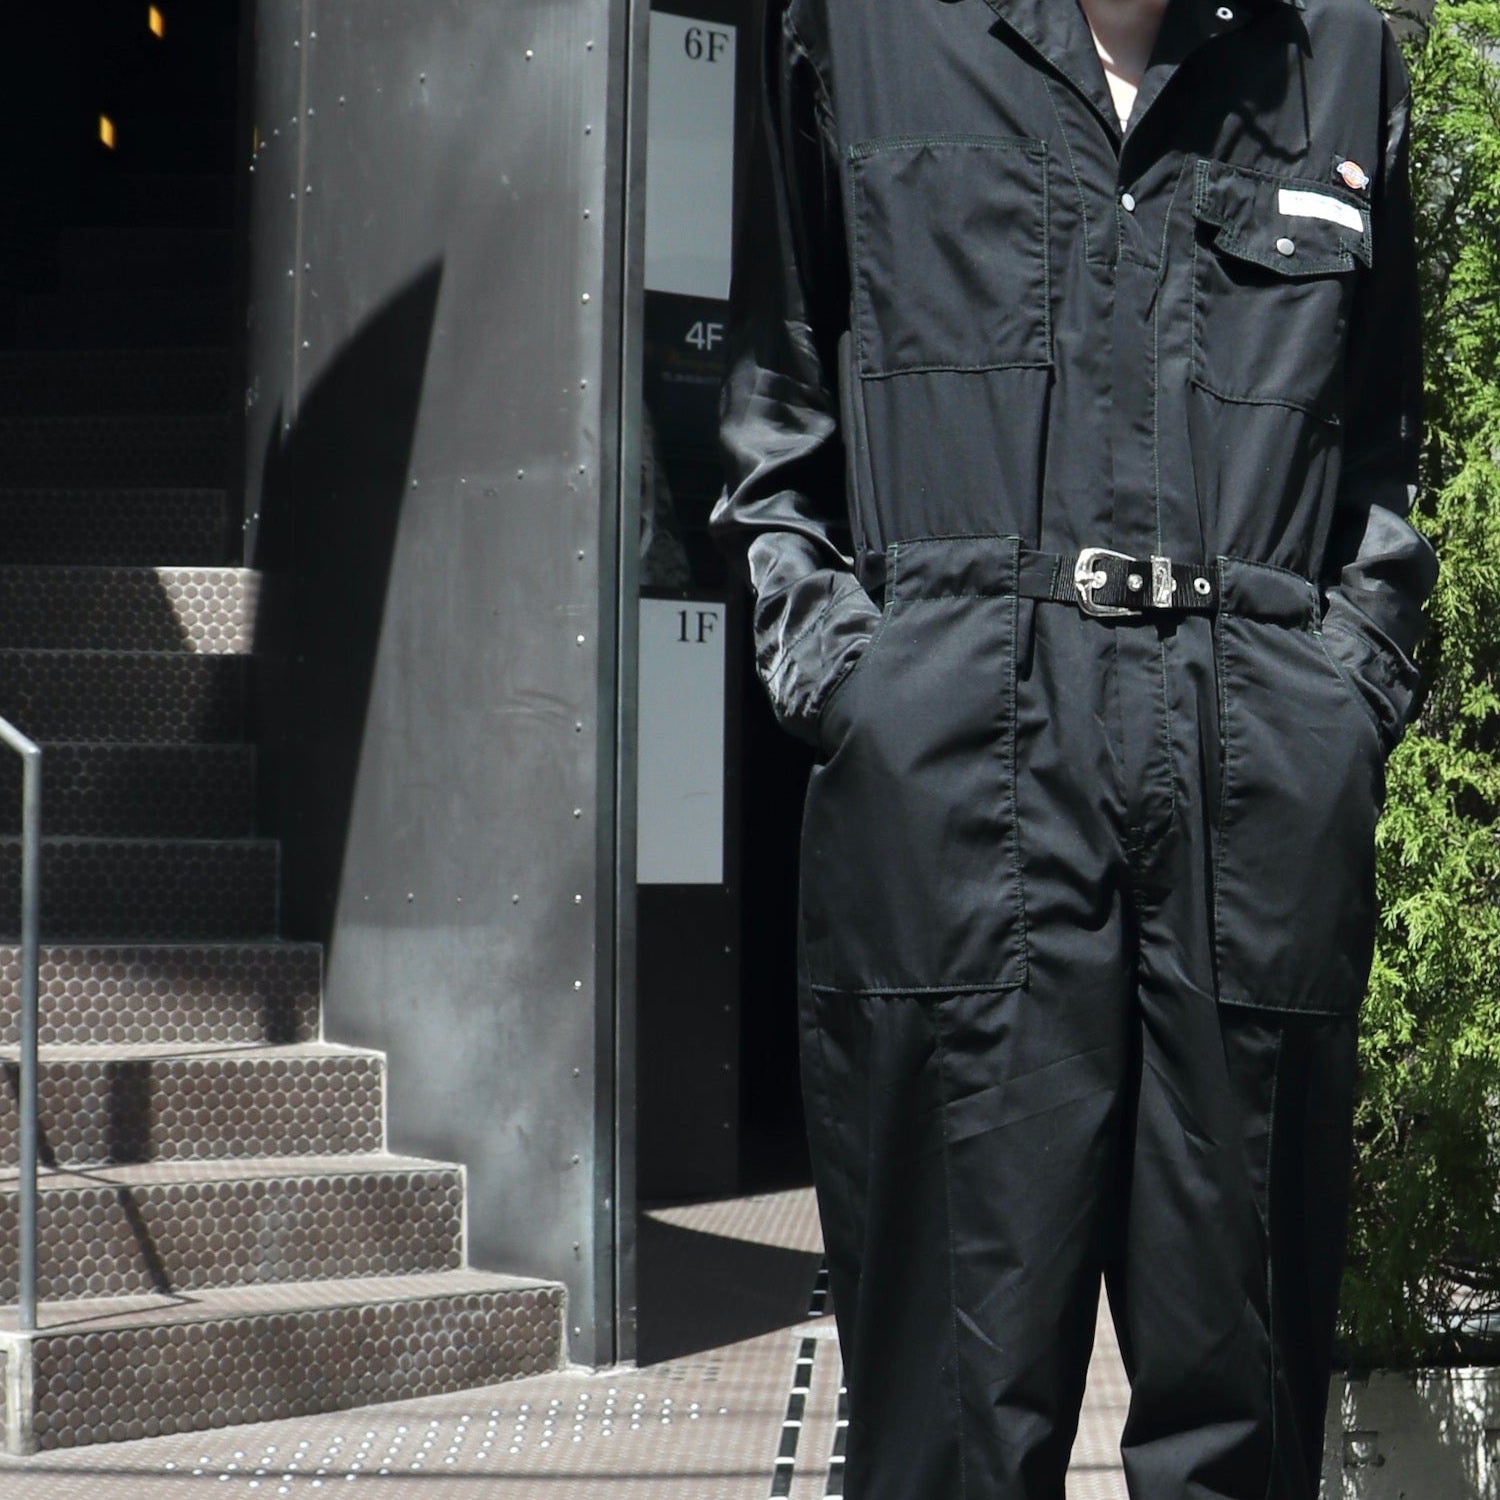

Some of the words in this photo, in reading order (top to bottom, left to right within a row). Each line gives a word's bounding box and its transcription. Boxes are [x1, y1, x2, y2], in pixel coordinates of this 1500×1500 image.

[685, 26, 729, 64] 6F
[684, 320, 724, 351] 4F
[677, 609, 719, 644] 1F
